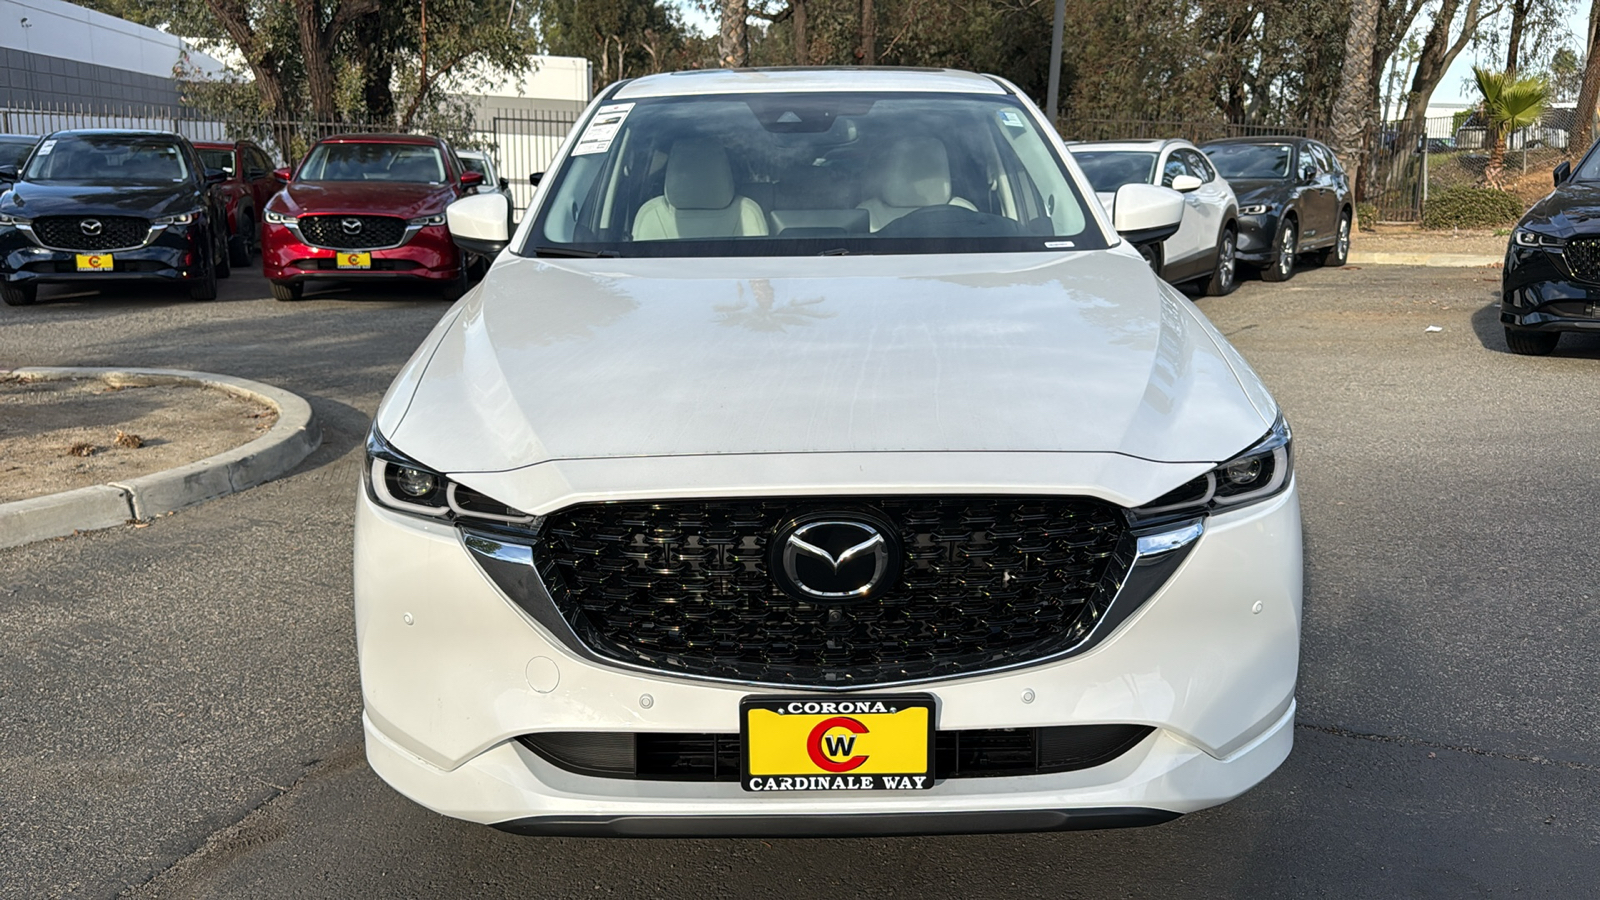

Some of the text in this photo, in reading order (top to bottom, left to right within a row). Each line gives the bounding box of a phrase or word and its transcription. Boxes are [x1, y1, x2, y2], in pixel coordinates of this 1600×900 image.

[787, 702, 887, 714] CORONA
[806, 716, 870, 773] C
[825, 734, 857, 757] W
[749, 776, 927, 791] CARDINALE WAY
